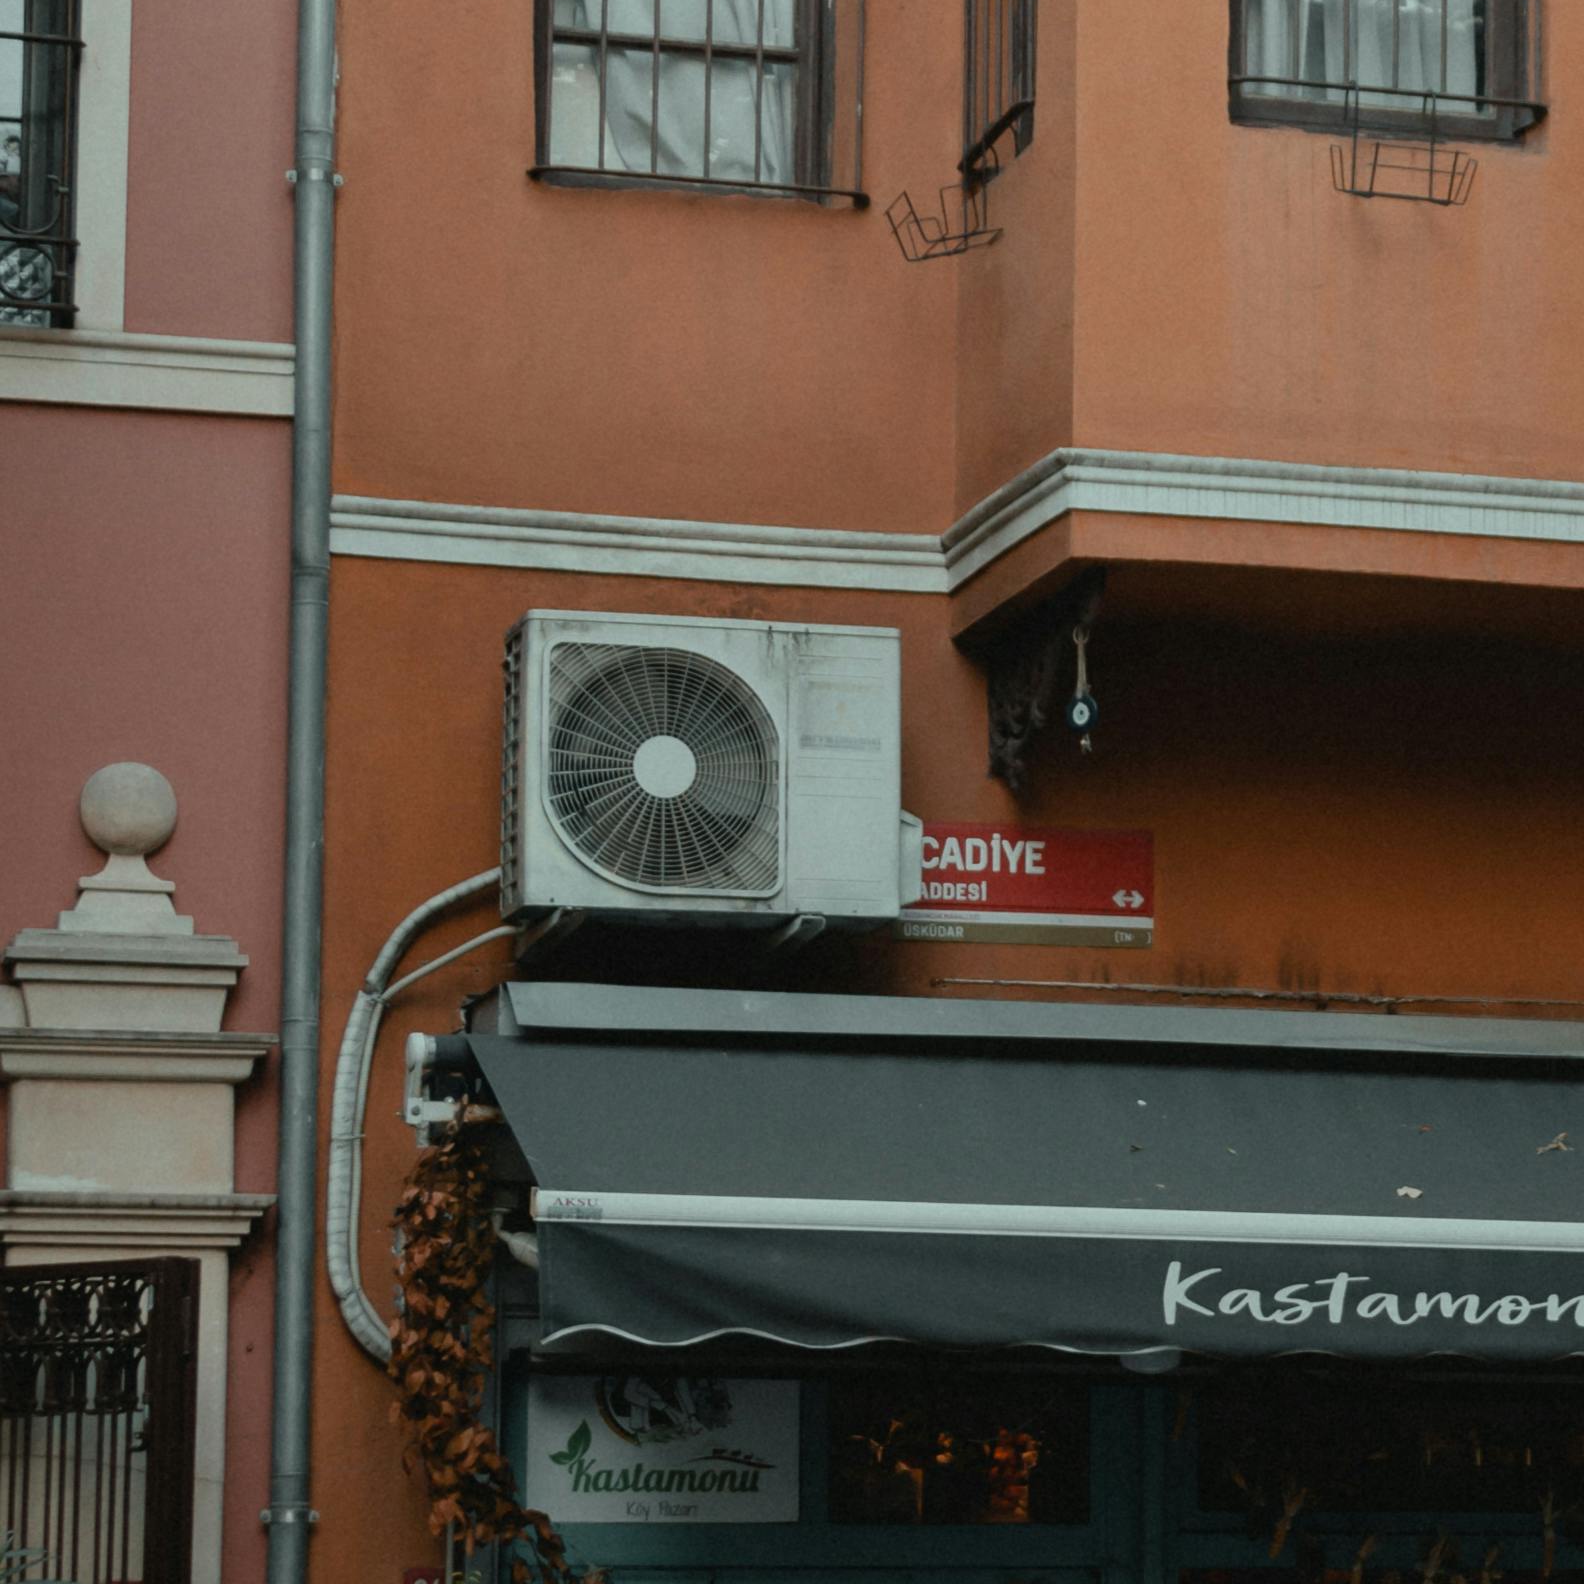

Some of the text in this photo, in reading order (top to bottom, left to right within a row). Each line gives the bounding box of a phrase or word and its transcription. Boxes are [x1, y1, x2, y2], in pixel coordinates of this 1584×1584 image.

[920, 833, 1046, 875] CADİYE
[919, 881, 987, 902] ADDESİ
[903, 922, 964, 938] ÜSKÜDAR
[553, 1197, 600, 1207] AKSU
[568, 1457, 760, 1494] Kastamonu
